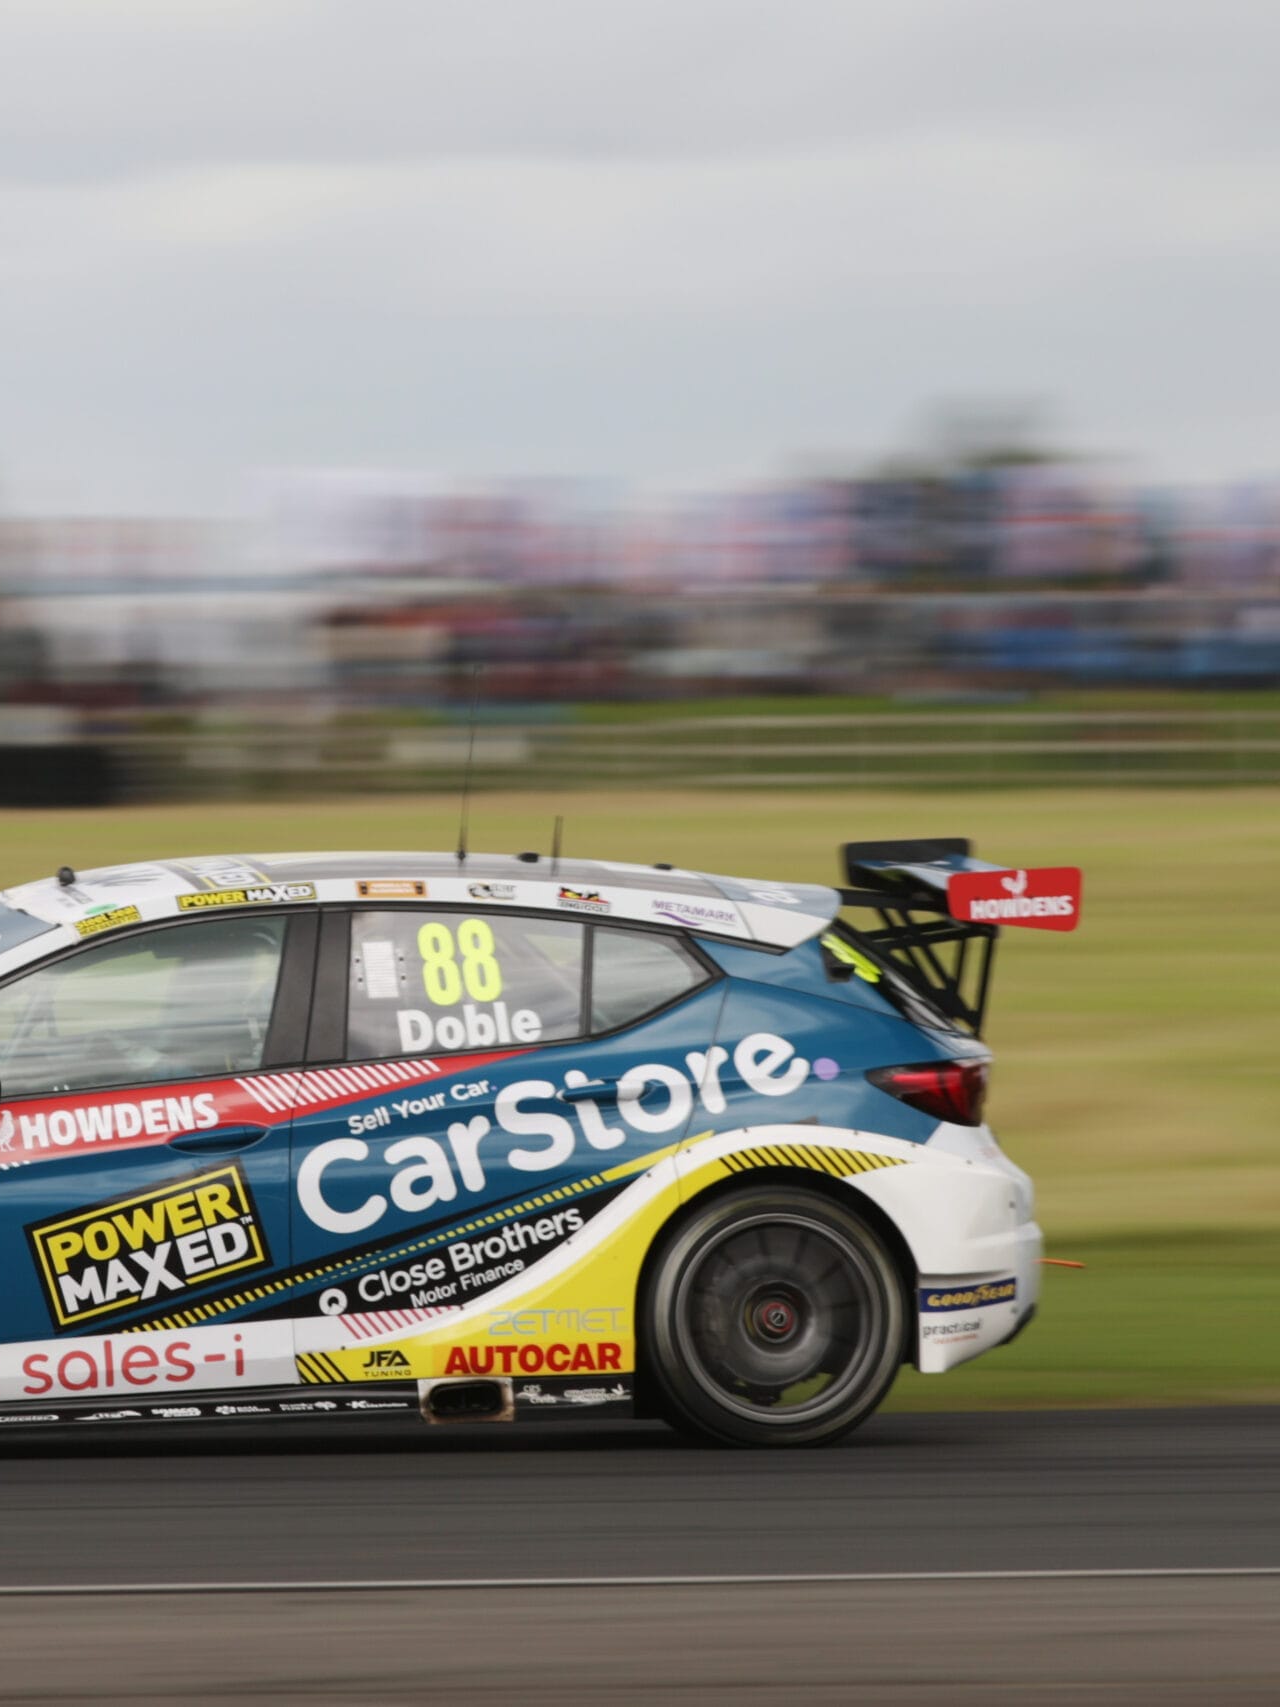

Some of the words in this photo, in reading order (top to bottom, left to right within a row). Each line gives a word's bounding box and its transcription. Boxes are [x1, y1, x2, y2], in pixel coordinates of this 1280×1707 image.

[181, 890, 245, 908] POWER
[247, 884, 313, 903] MAXED
[651, 899, 737, 922] METAMARK
[969, 895, 1074, 919] HOWDENS
[417, 918, 503, 1006] 88
[396, 1001, 542, 1053] Doble
[19, 1093, 220, 1150] HOWDENS
[347, 1106, 391, 1135] Sell
[392, 1092, 446, 1119] Your
[46, 1183, 240, 1275] POWER
[358, 1258, 447, 1302] Close
[447, 1208, 584, 1273] Brothers
[57, 1222, 249, 1314] MAXED
[410, 1281, 458, 1309] Motor
[460, 1257, 525, 1291] Finance
[22, 1333, 245, 1395] sales-i
[362, 1349, 411, 1368] JFA
[363, 1368, 412, 1378] TUNING
[443, 1342, 623, 1376] AUTOCAR
